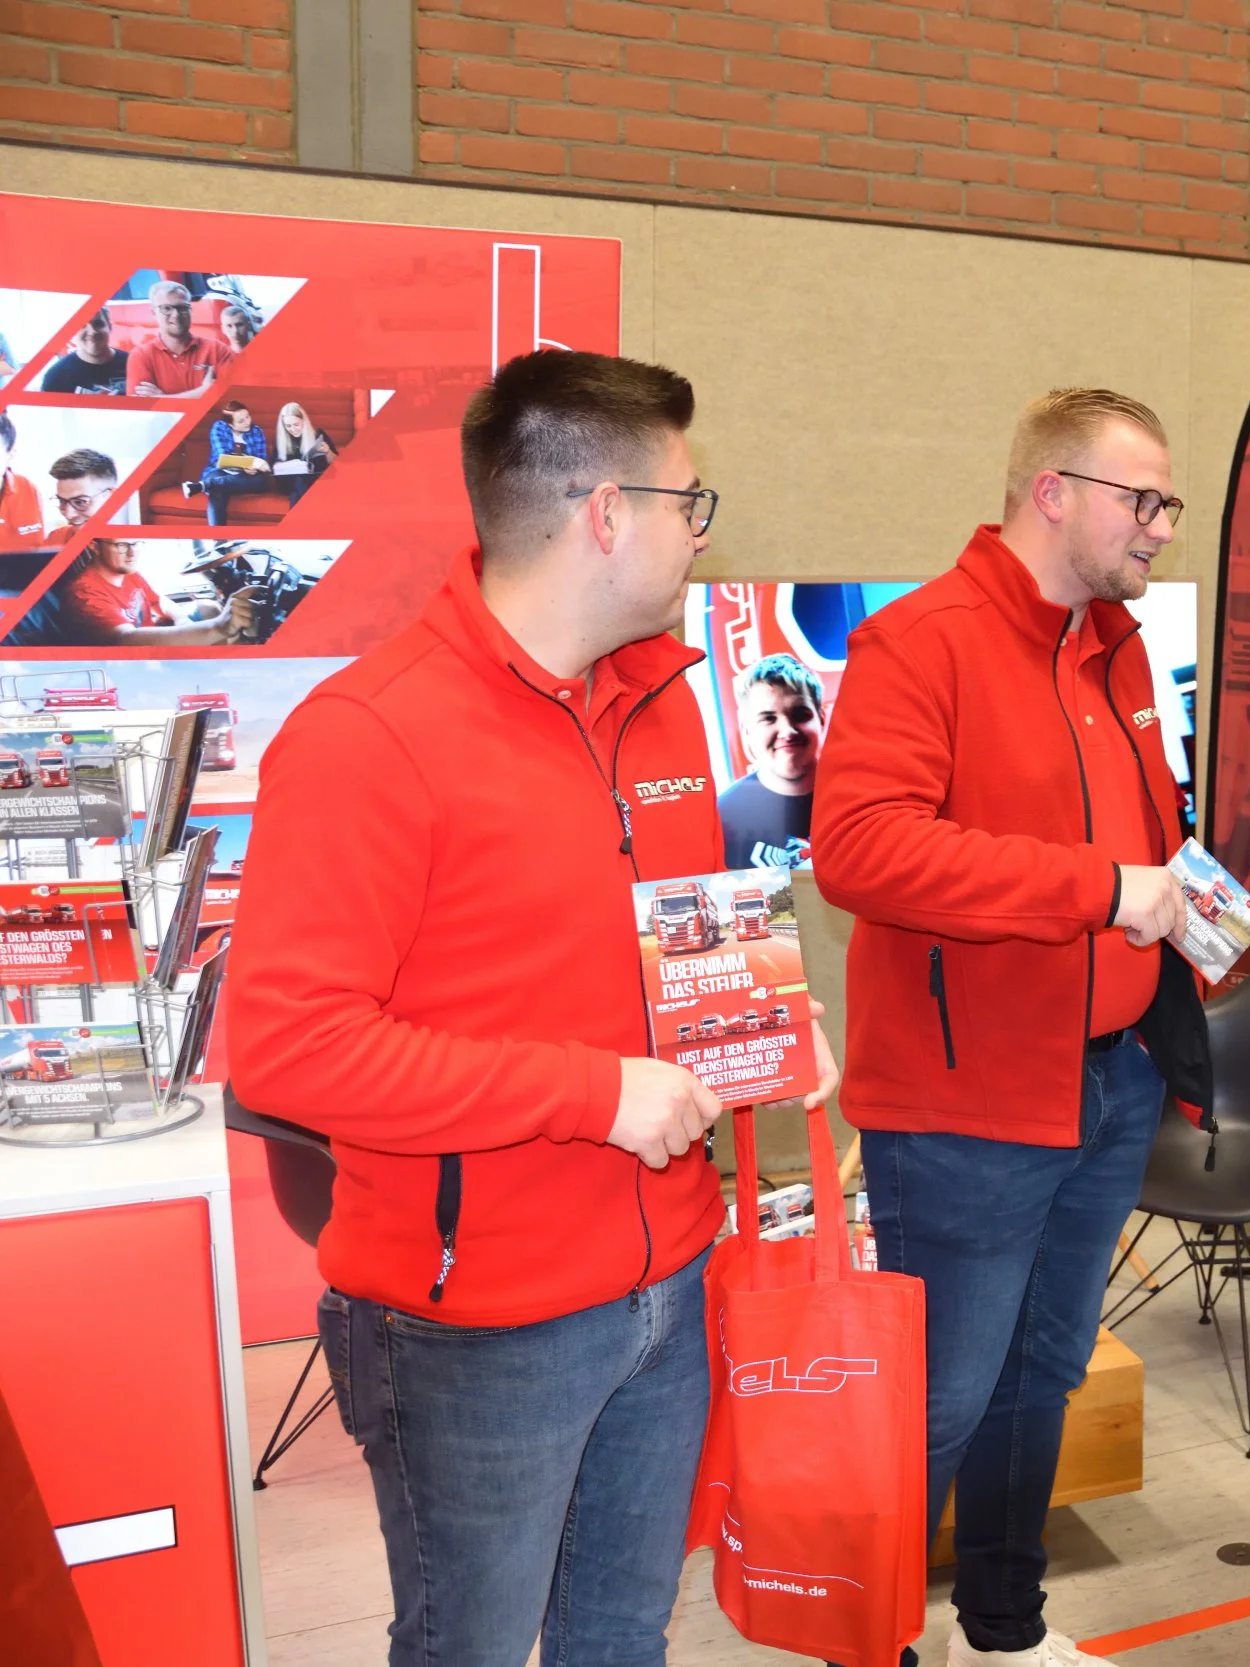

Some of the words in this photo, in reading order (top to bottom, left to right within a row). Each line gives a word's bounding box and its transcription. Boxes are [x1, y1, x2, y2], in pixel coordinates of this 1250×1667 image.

[10, 807, 39, 818] ALLEN
[40, 805, 80, 817] KLASSEN
[7, 931, 29, 943] DEN
[31, 928, 86, 942] GRÖSSTEN
[51, 941, 73, 952] DES
[659, 952, 747, 983] ÜBERNIMM
[676, 1049, 701, 1065] LUST
[703, 1046, 723, 1059] AUF
[724, 1042, 745, 1056] DEN
[746, 1033, 797, 1053] GRÖSSTEN
[693, 1053, 764, 1076] DIENSTWAGEN
[765, 1049, 785, 1062] DES
[701, 1062, 780, 1088] WESTERWALDS?
[24, 1094, 42, 1105] MIT
[43, 1094, 51, 1104] 5
